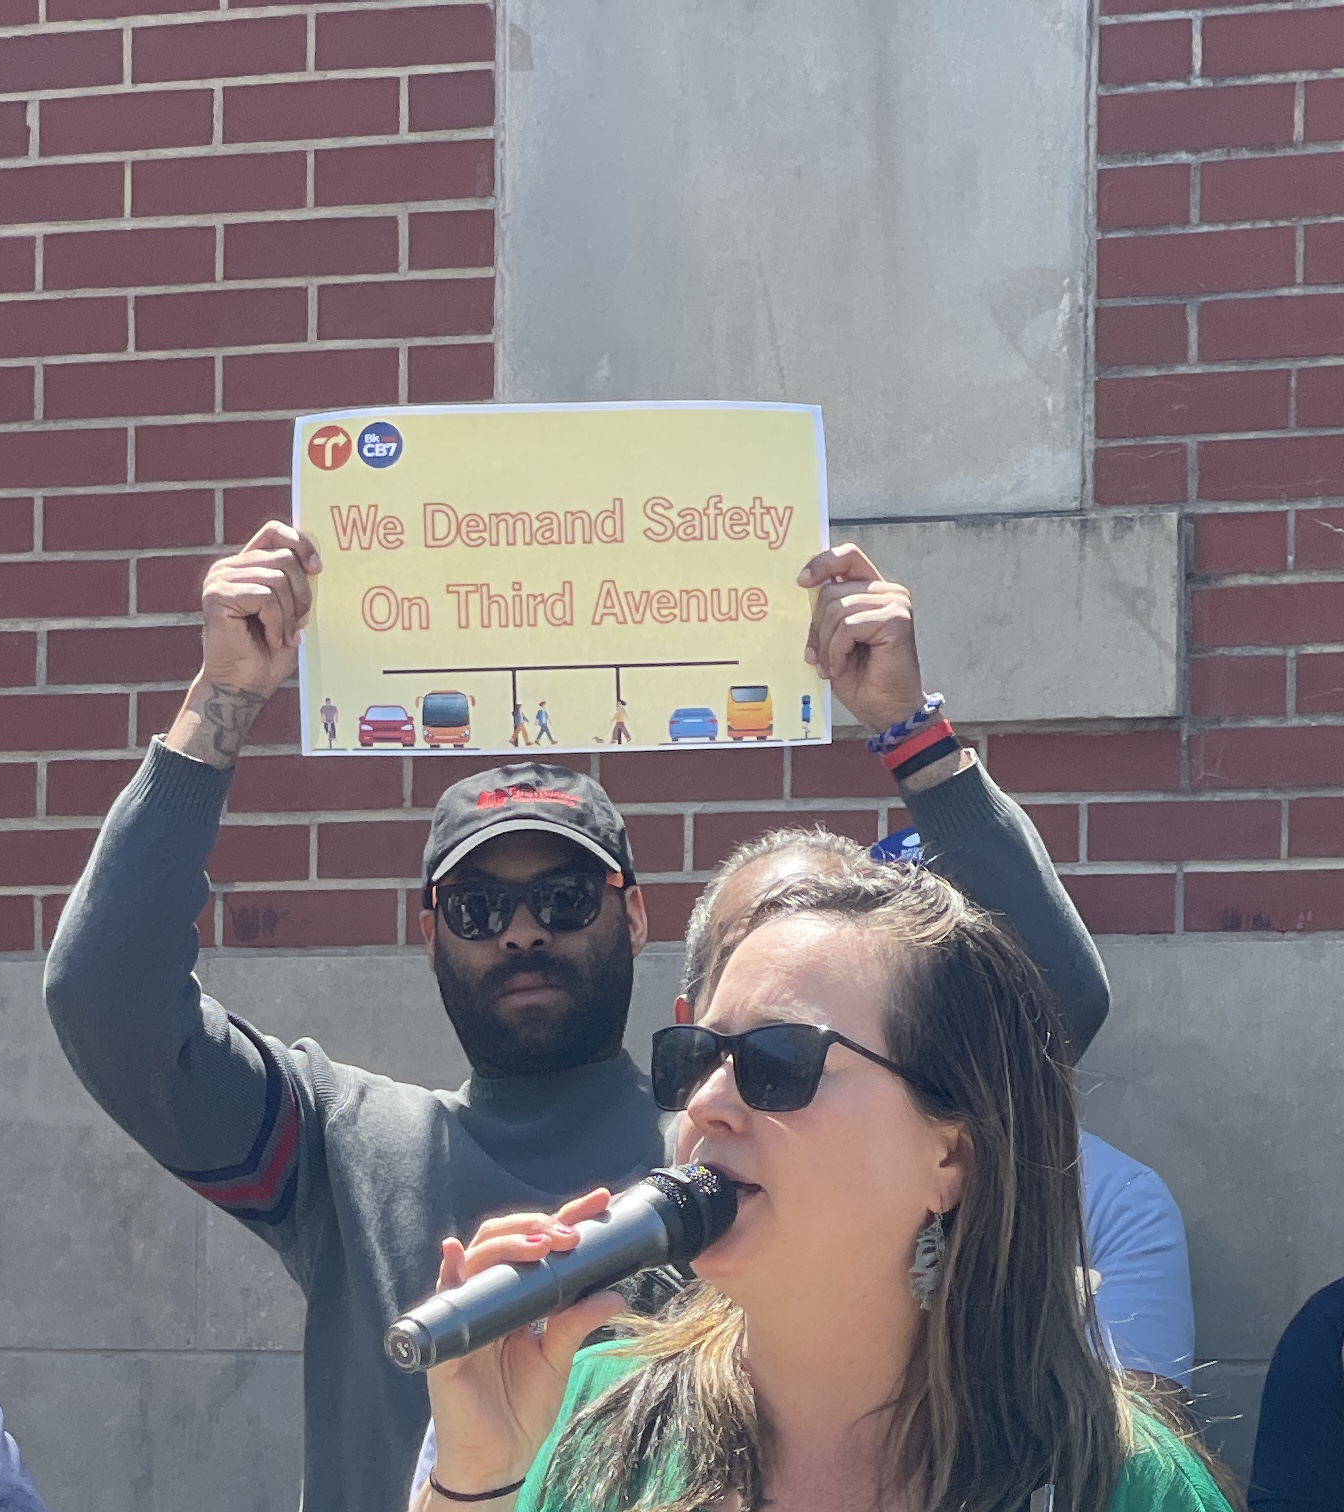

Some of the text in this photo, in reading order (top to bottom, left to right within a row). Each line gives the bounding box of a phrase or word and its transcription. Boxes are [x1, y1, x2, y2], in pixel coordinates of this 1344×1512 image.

[362, 442, 398, 457] CB7
[330, 494, 795, 552] We Demand Safety
[361, 579, 769, 633] On Third Avenue
